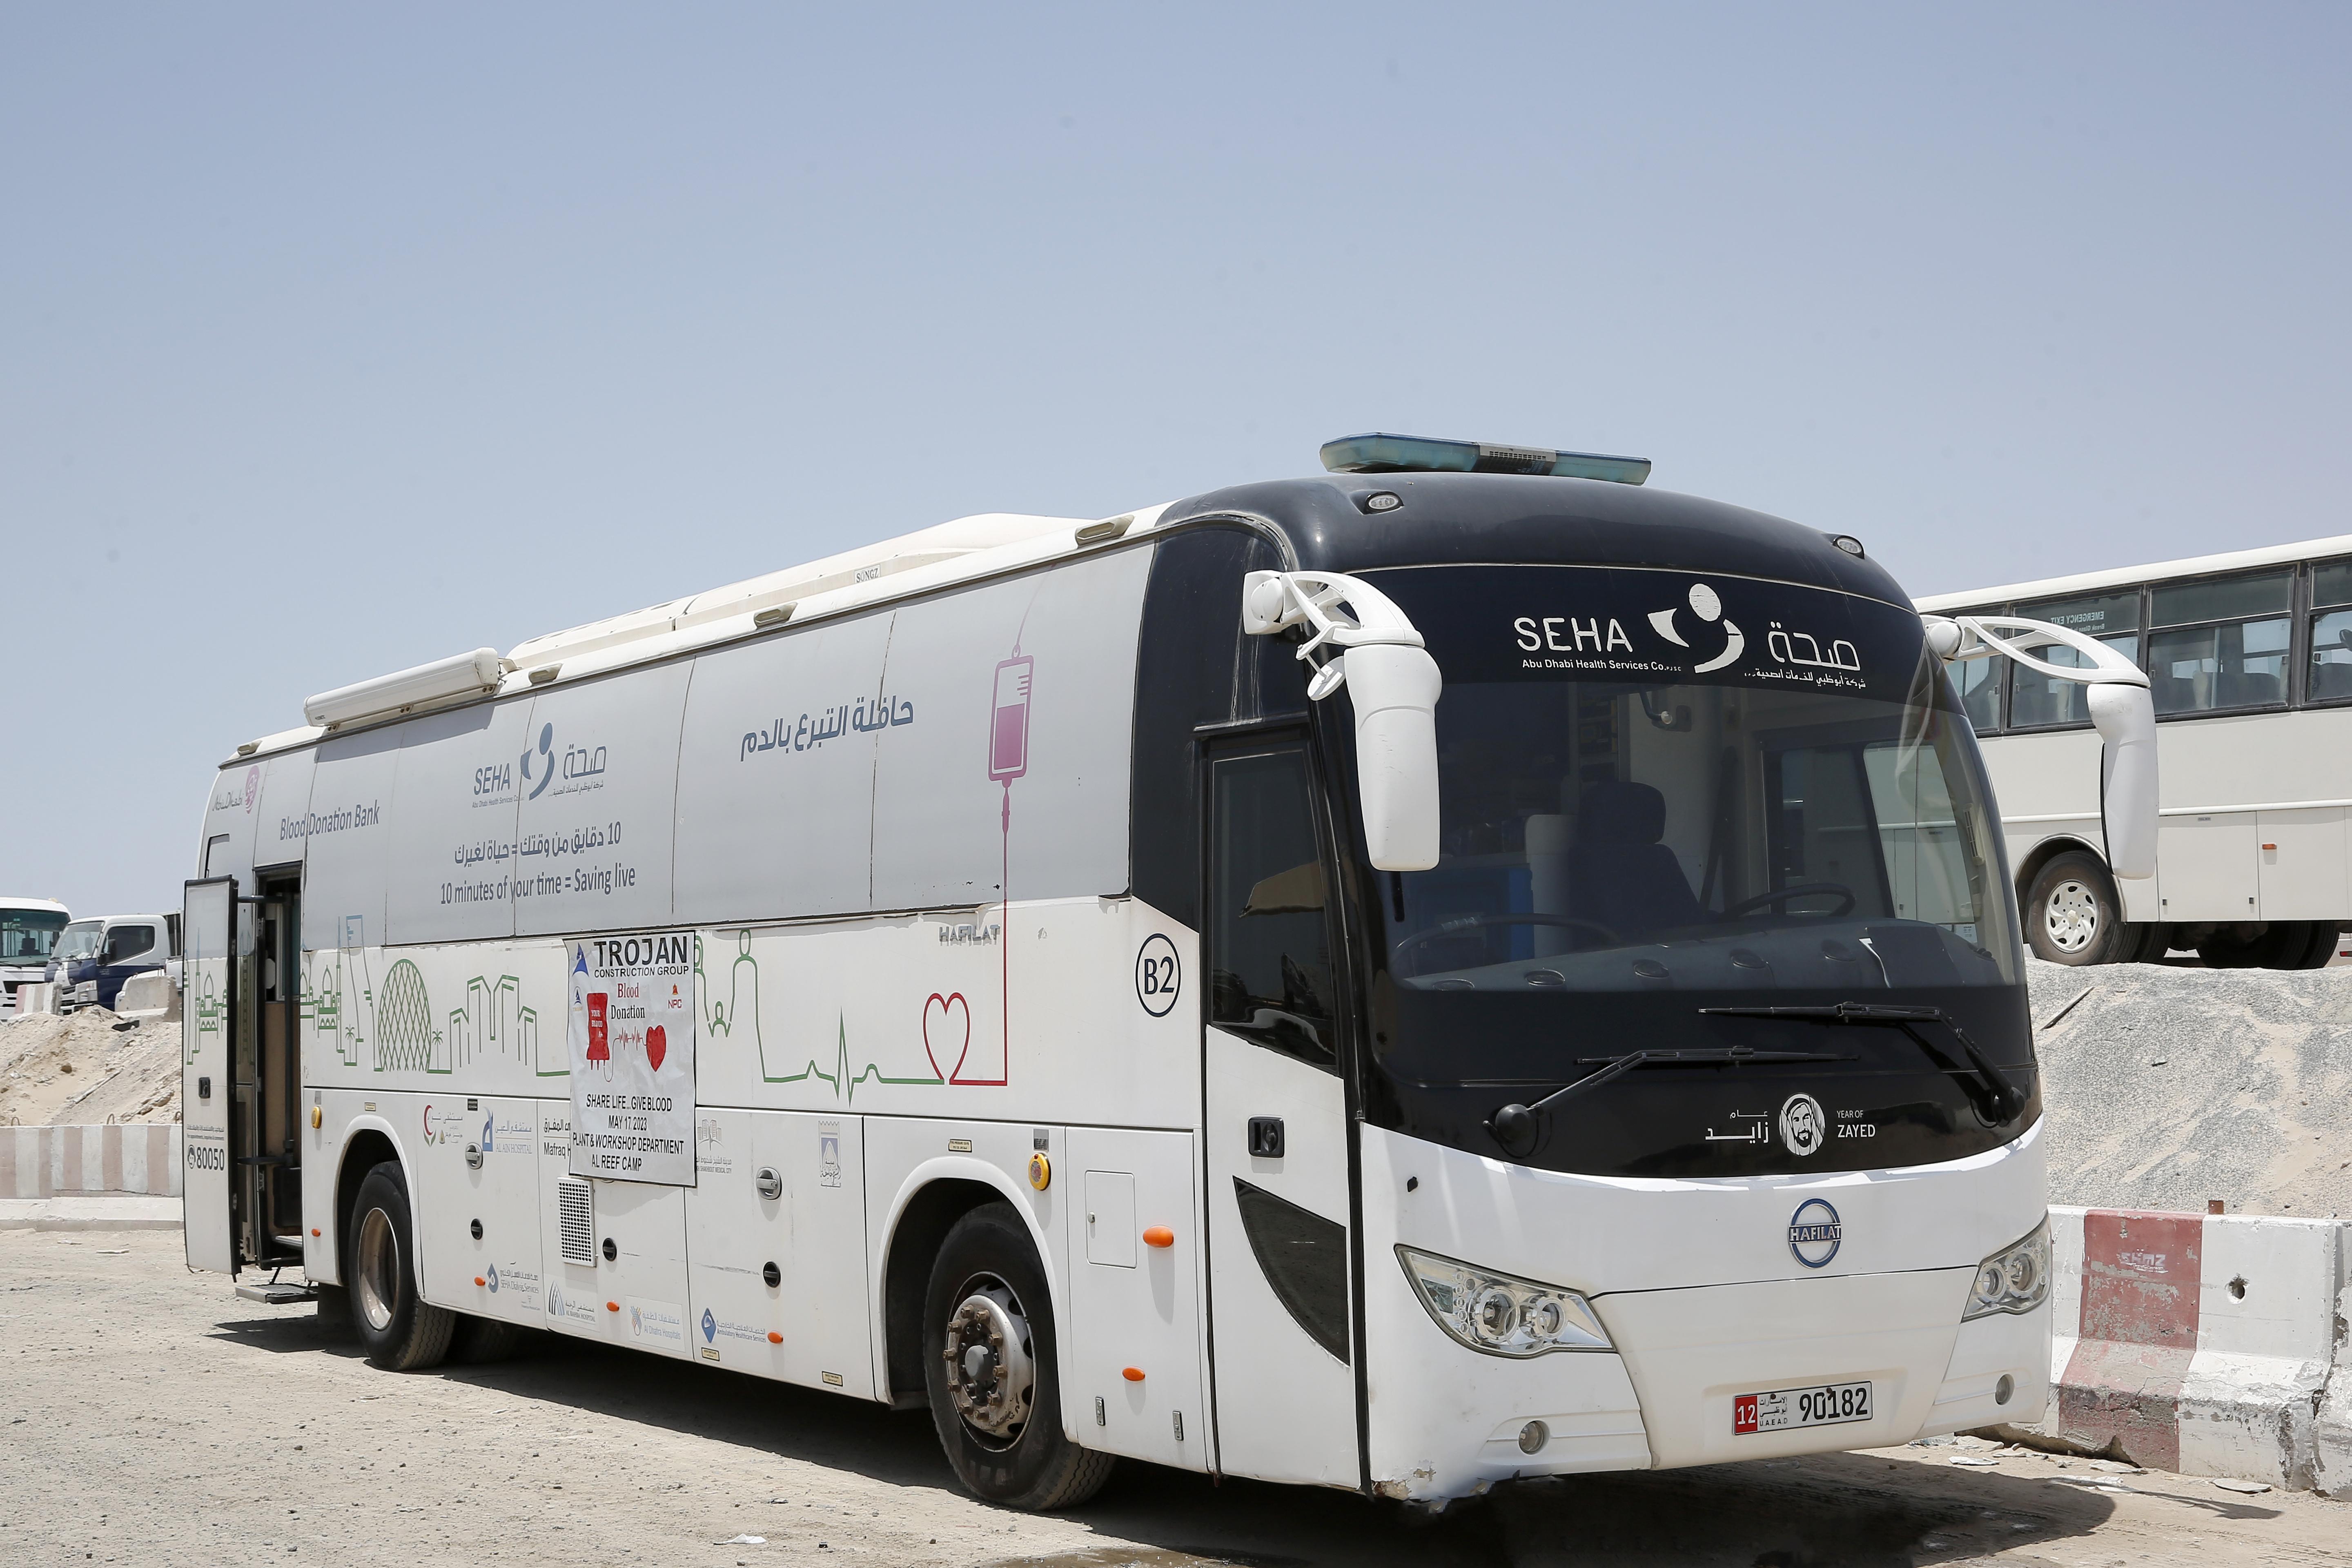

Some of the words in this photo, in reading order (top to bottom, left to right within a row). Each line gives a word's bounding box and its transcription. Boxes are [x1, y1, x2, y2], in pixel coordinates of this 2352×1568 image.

[856, 568, 878, 583] SONGZ
[1514, 616, 1633, 652] SEHA
[1767, 620, 1861, 672] صحة
[1522, 659, 1542, 669] Abu
[1545, 659, 1572, 669] Dhabi
[1575, 659, 1607, 670] Health
[1609, 659, 1648, 671] Services
[1816, 672, 1844, 688] أبوظبي
[1845, 678, 1866, 689] شركة
[852, 695, 913, 732] حافلة
[794, 704, 849, 751] التبرع
[740, 717, 791, 762] بالدم
[564, 744, 606, 780] صحة
[474, 763, 510, 795] SEHA
[499, 796, 513, 804] Services
[280, 813, 306, 840] Blood
[308, 807, 352, 835] Donation
[355, 800, 380, 828] Bank
[608, 821, 621, 844] 10
[487, 840, 509, 864] حياة
[520, 833, 550, 858] وقتك
[552, 832, 568, 857] من
[454, 841, 485, 868] لغيرك
[441, 882, 452, 904] 10
[454, 880, 494, 903] minutes
[497, 875, 508, 899] of
[510, 880, 534, 903] your
[537, 871, 561, 897] time
[565, 875, 571, 888] =
[574, 865, 611, 895] Saving
[615, 862, 636, 888] live
[939, 924, 1000, 943] HAFILAT
[594, 936, 687, 967] TROJAN
[594, 967, 655, 978] CONSTRUCTION
[657, 965, 689, 976] GROUP
[1144, 956, 1175, 995] B2
[617, 982, 639, 998] Blood
[611, 1004, 645, 1020] Donation
[668, 999, 682, 1009] NPC
[586, 1094, 610, 1108] SHARE
[648, 1097, 672, 1111] BLOOD
[608, 1115, 623, 1129] MAY
[633, 1117, 647, 1131] 2023
[1730, 1110, 1767, 1119] عام
[1705, 1121, 1769, 1143] زايد
[1838, 1124, 1876, 1138] ZAYED
[511, 1144, 532, 1154] HOSPITAL
[544, 1142, 566, 1159] Mafraq
[573, 1132, 590, 1147] PLANT
[590, 1134, 595, 1147] &
[595, 1134, 637, 1151] WORKSHOP
[638, 1137, 684, 1155] DEPARTMENT
[197, 1147, 224, 1171] 80050
[591, 1154, 599, 1168] AL
[601, 1155, 620, 1170] REEF
[621, 1156, 642, 1172] CAMP
[1789, 1225, 1842, 1242] HAFILAT
[501, 1279, 511, 1289] SEHA
[524, 1283, 539, 1294] Services
[662, 1329, 681, 1340] Hospitals
[717, 1328, 735, 1339] Ambulatory
[735, 1332, 753, 1340] Healthcare
[753, 1334, 766, 1343] Services
[1800, 1388, 1867, 1421] 90182
[1737, 1405, 1756, 1425] 12
